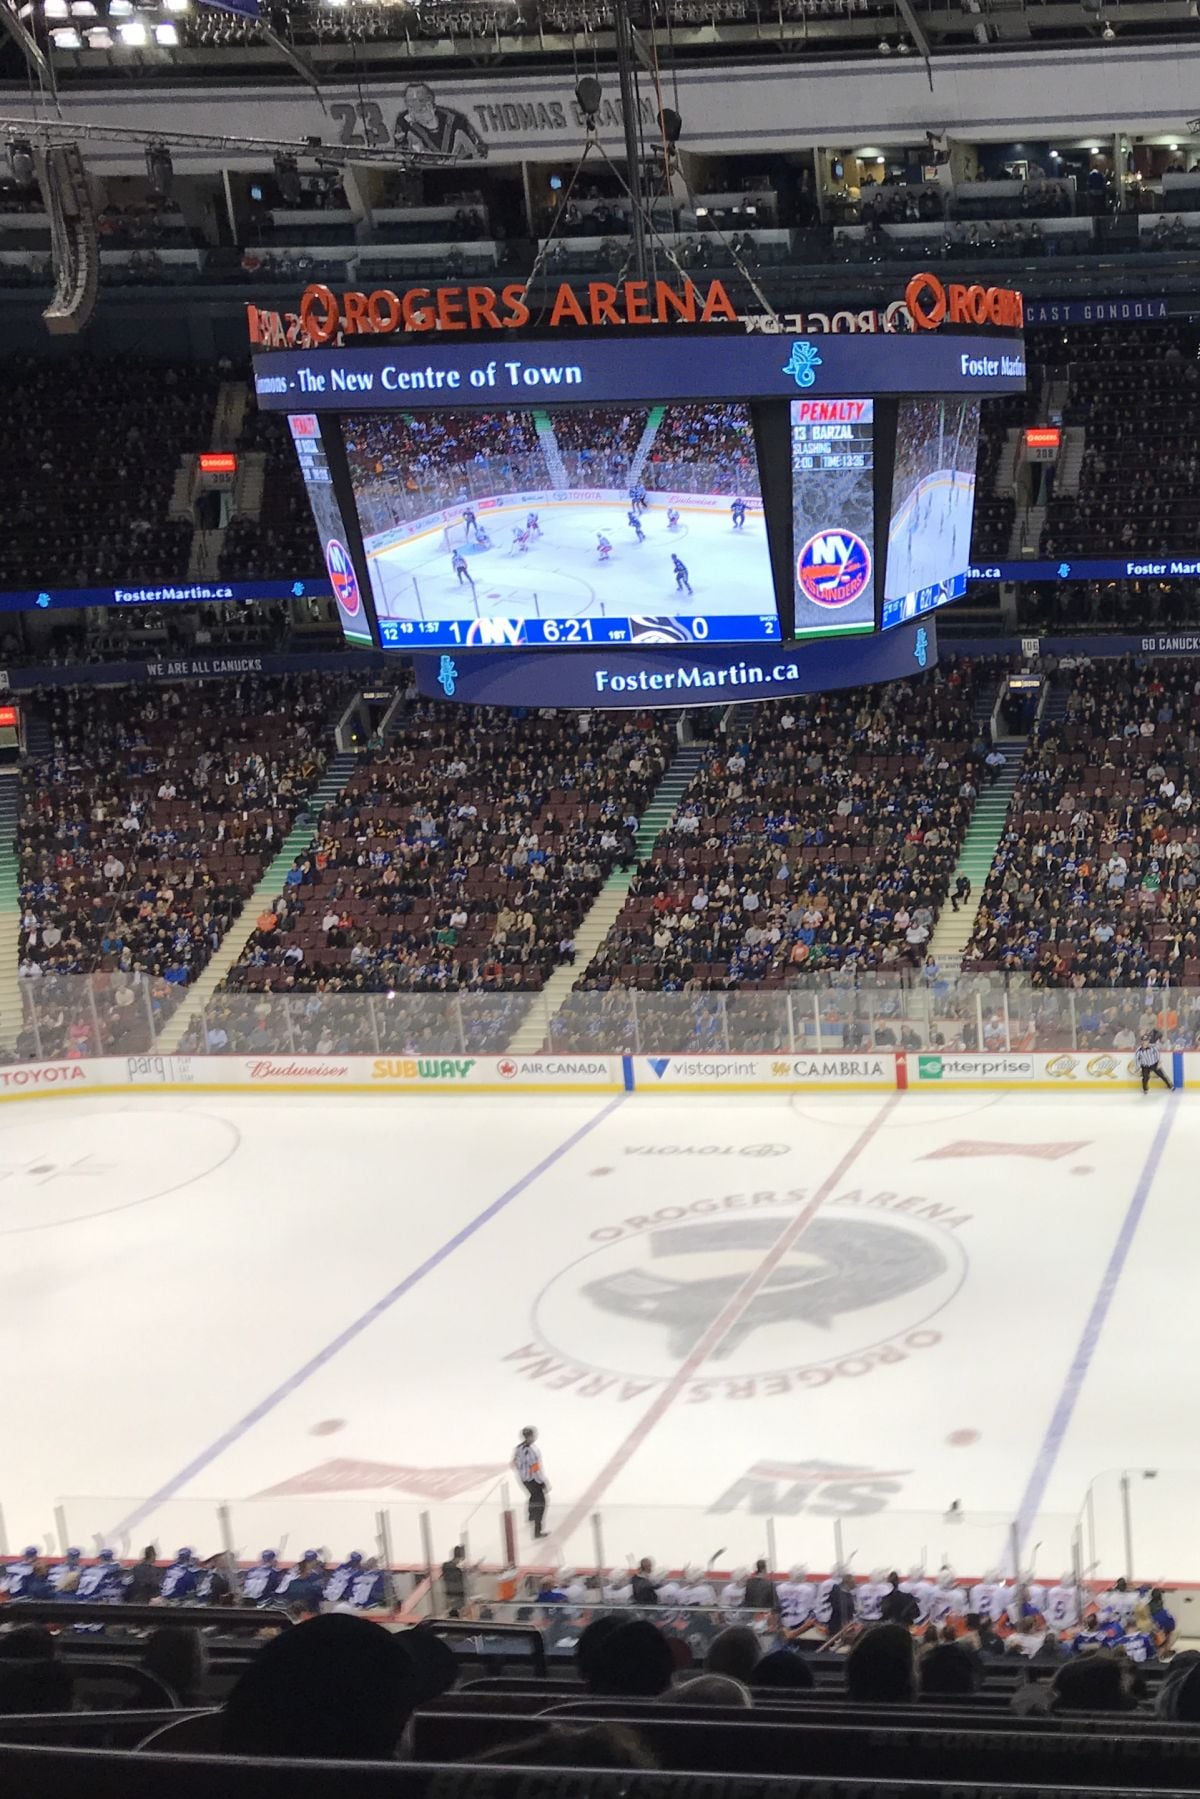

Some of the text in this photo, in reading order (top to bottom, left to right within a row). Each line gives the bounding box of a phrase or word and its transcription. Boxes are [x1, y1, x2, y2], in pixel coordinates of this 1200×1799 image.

[473, 100, 567, 133] THOMAS
[344, 282, 531, 335] ROGERS
[550, 279, 738, 328] ARENA
[1084, 303, 1167, 319] GONDOLA
[961, 353, 999, 377] Foster
[298, 367, 326, 392] The
[330, 368, 374, 391] New
[380, 366, 461, 391] Centre
[469, 360, 497, 388] of
[505, 361, 583, 386] Town
[800, 402, 865, 422] PENALTY
[793, 425, 854, 441] 13 BARZAL
[1126, 562, 1166, 576] Foster
[114, 585, 234, 603] FosterMartin.ca
[805, 576, 862, 601] ISLANDERS
[383, 628, 399, 641] 12
[418, 622, 440, 633] 1:57
[449, 621, 462, 644] 1
[542, 618, 594, 642] 6:21
[691, 616, 709, 640] 0
[764, 622, 775, 634] 2
[1142, 637, 1156, 650] GO
[147, 658, 262, 676] WE ARE ALL CANUCKS
[595, 662, 800, 693] FosterMartin.ca
[1, 1065, 86, 1087] TOYOTA
[127, 1056, 165, 1082] parq
[245, 1060, 348, 1080] Budweiser
[371, 1058, 477, 1080] SUBWAY
[520, 1062, 608, 1075] AIR CANADA
[673, 1060, 757, 1079] vistaprint
[793, 1060, 884, 1077] CAMBRIA
[920, 1059, 1032, 1075] enterprise
[620, 1187, 975, 1230] ROGERS ARENA
[500, 1341, 910, 1404] ROGERS ARENA
